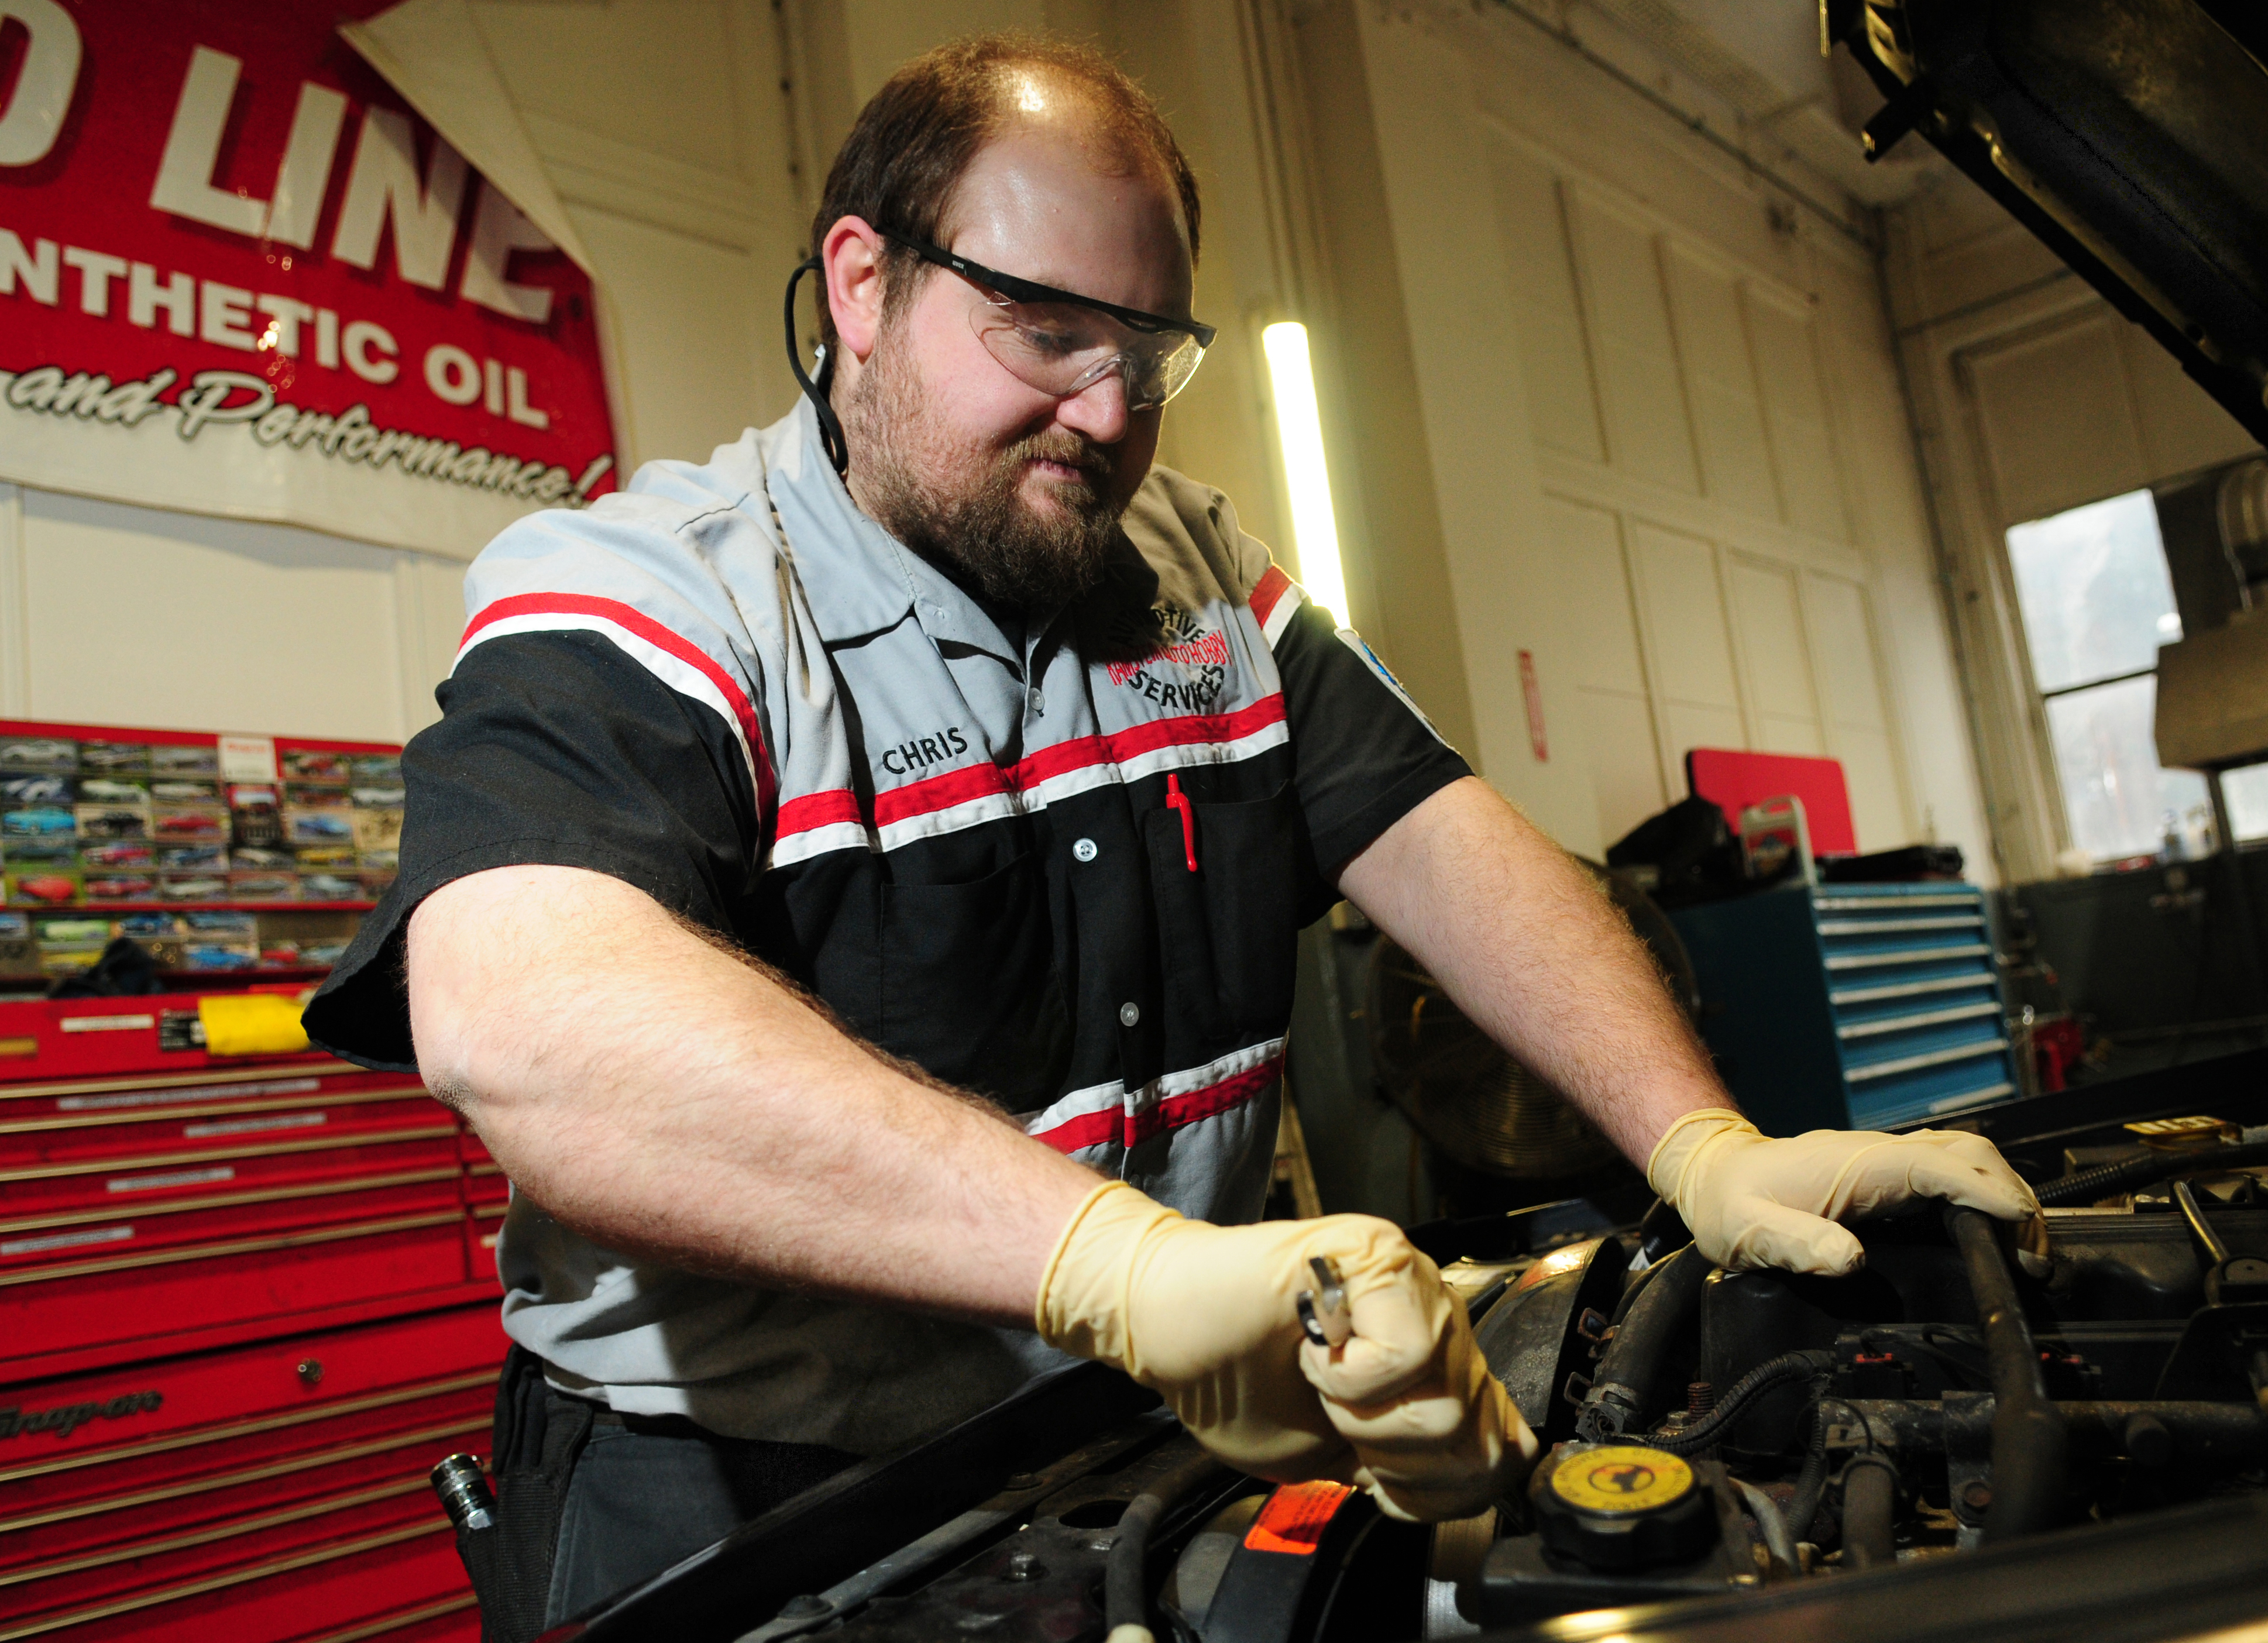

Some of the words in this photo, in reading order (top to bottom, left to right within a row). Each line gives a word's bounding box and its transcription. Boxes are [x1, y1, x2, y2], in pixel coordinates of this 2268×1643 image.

[149, 43, 558, 324] LINE
[422, 344, 550, 428] OIL
[7, 365, 178, 429] and
[177, 369, 614, 508] Performance!
[1187, 629, 1233, 666] HOBBY
[1128, 665, 1225, 710] SERVICES
[882, 727, 968, 775] CHRIS
